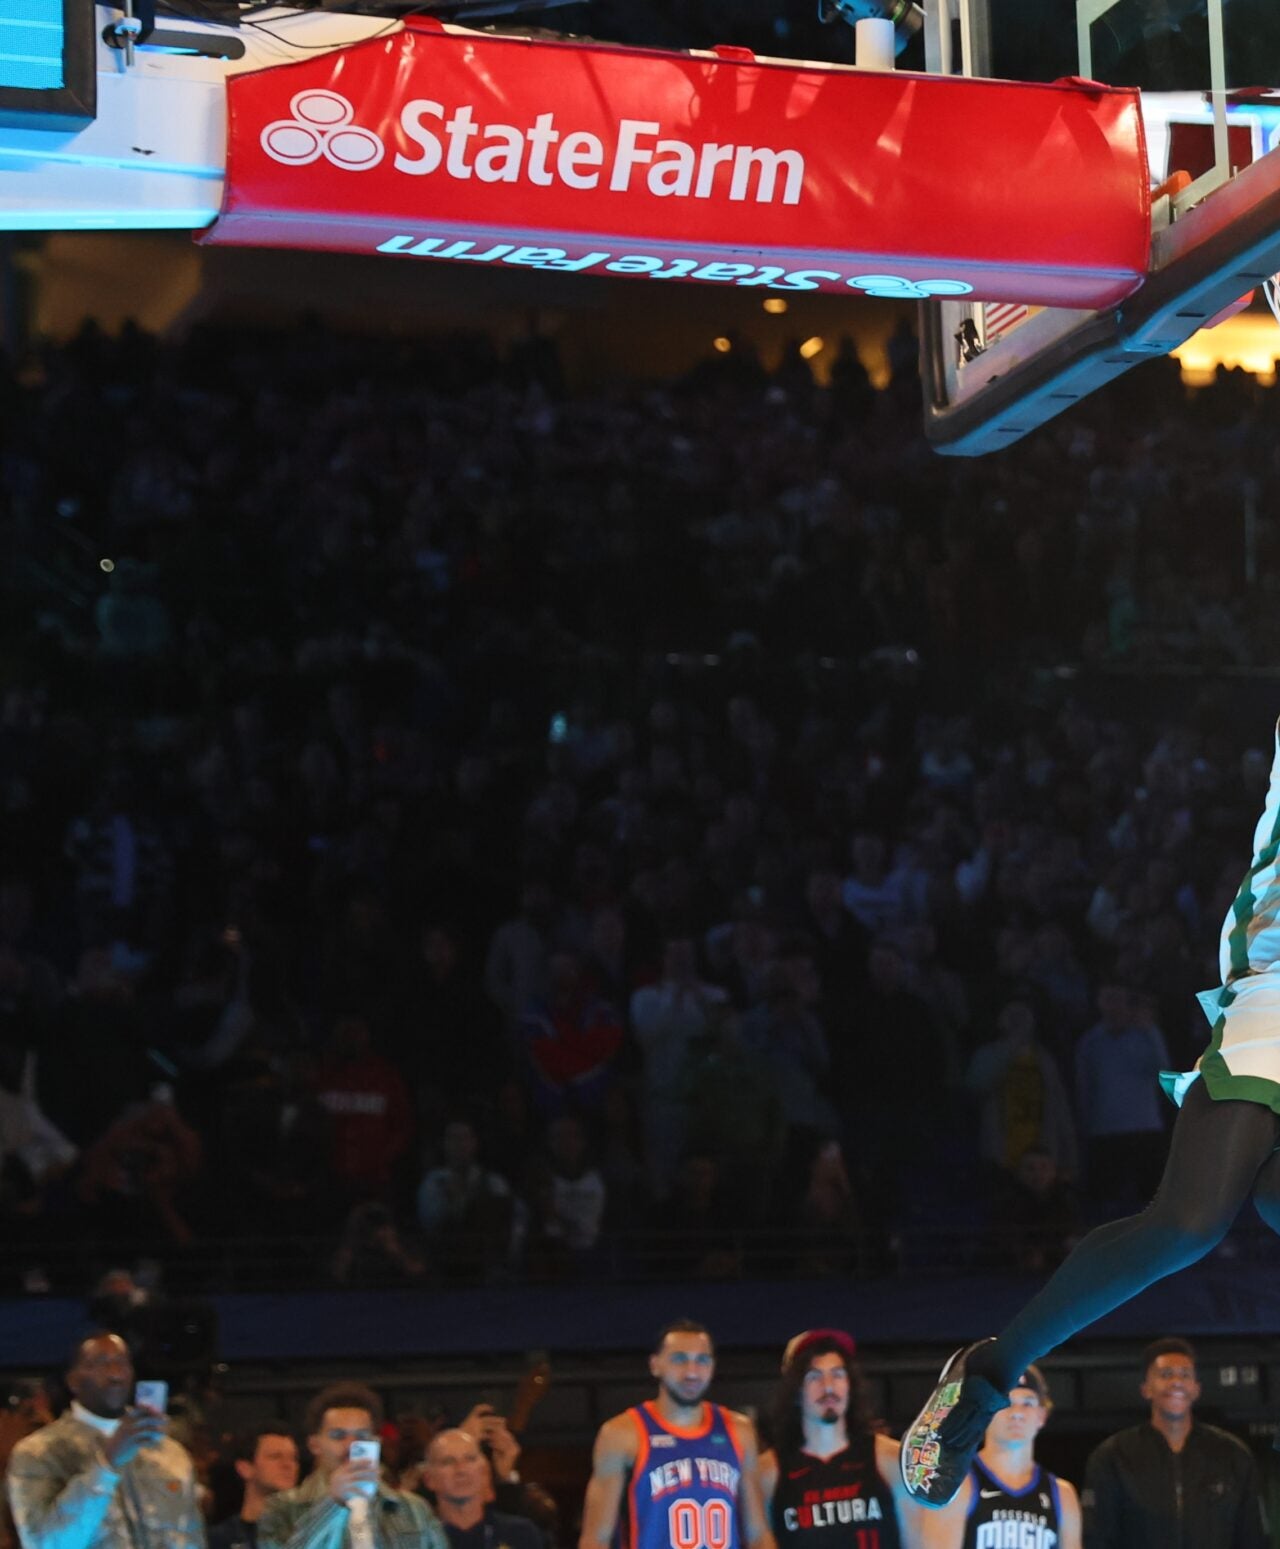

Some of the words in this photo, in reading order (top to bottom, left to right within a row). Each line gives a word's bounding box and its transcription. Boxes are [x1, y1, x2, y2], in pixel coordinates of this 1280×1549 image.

[649, 1458, 692, 1501] NEW
[694, 1457, 740, 1500] YORK
[668, 1498, 732, 1549] 00
[784, 1497, 882, 1531] CULTURA
